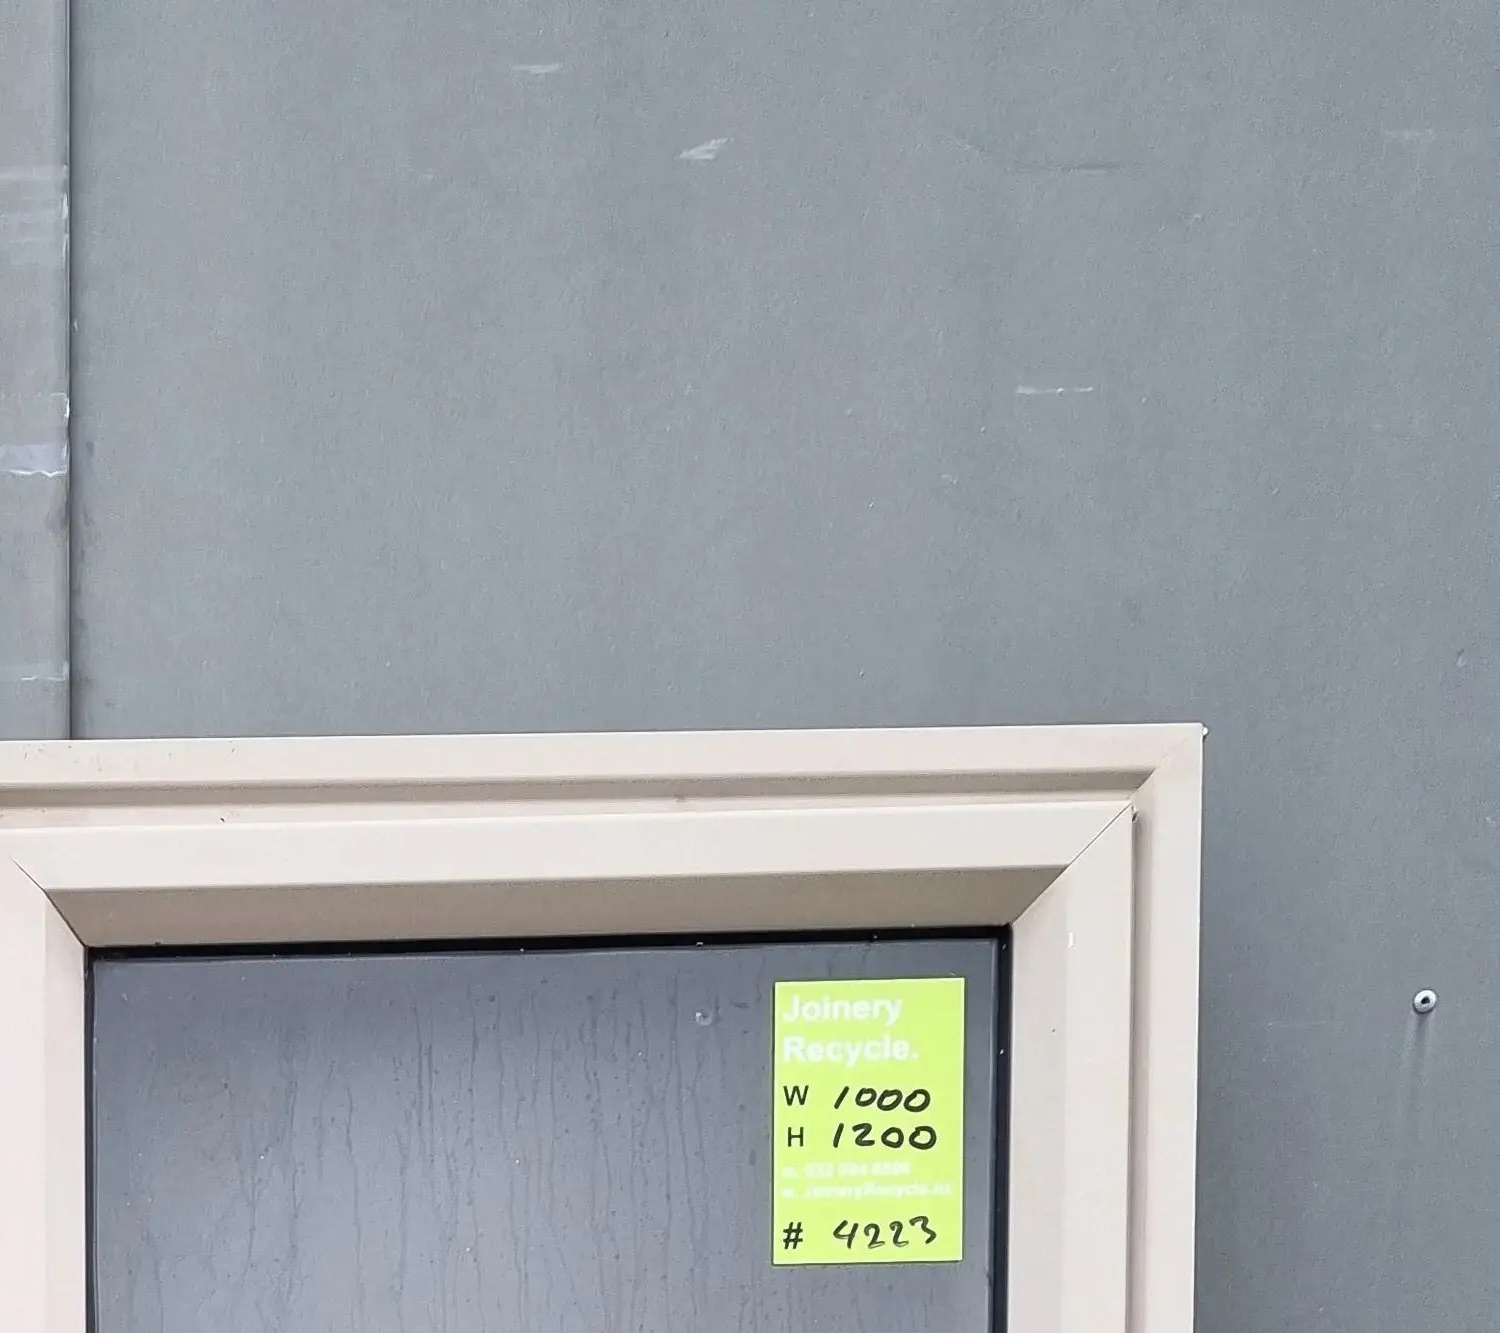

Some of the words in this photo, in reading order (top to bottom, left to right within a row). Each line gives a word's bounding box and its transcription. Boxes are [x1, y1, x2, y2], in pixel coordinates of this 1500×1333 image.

[783, 995, 903, 1026] Joinery
[783, 1034, 920, 1068] Recycle.
[783, 1085, 809, 1106] W
[833, 1086, 931, 1112] 1000
[787, 1126, 804, 1147] H
[832, 1123, 937, 1150] 1200
[783, 1221, 804, 1250] #
[832, 1215, 937, 1249] 4223
